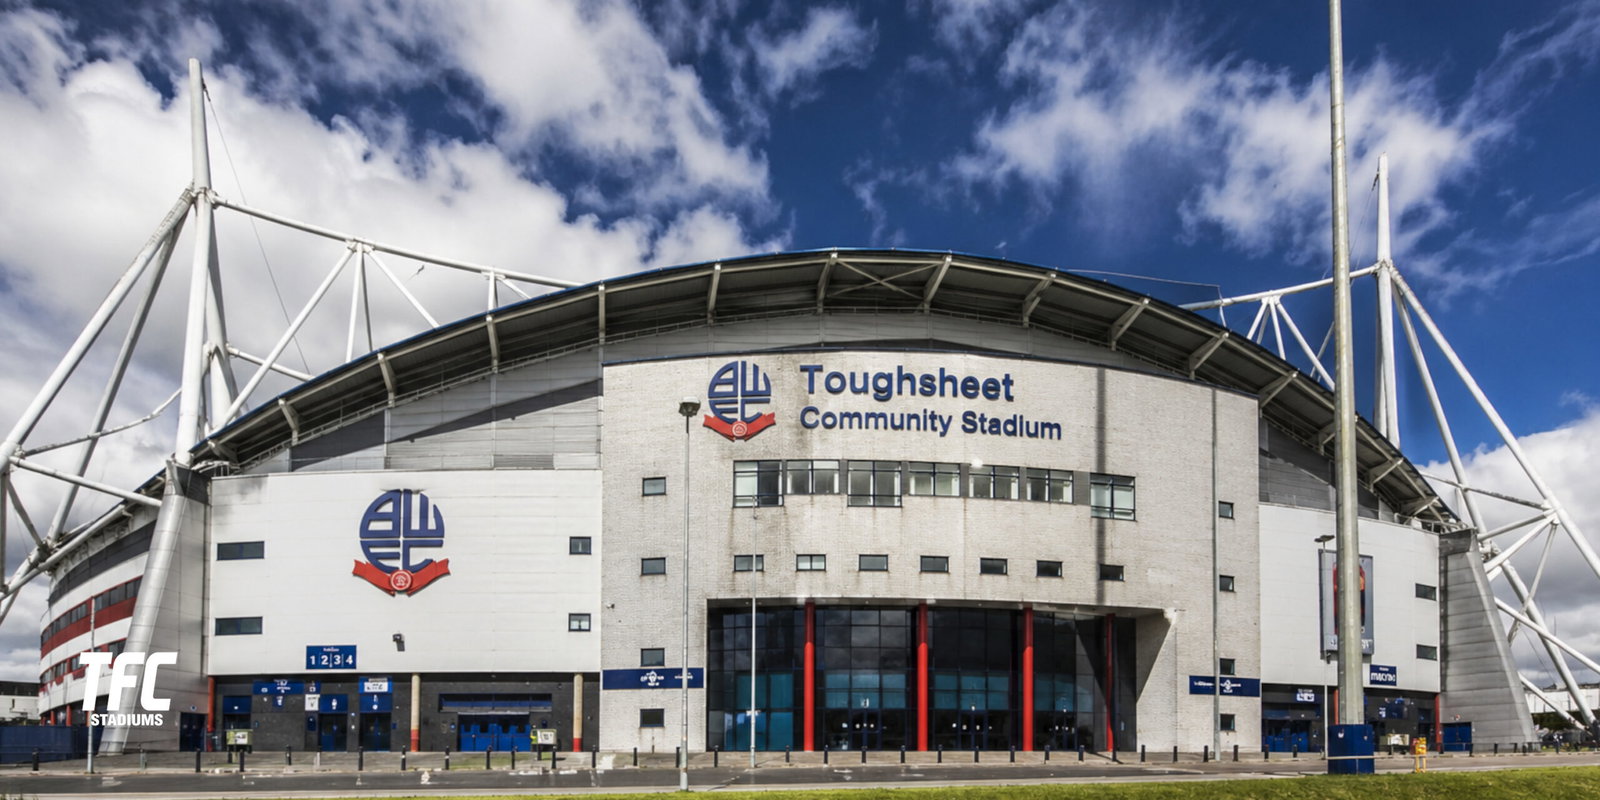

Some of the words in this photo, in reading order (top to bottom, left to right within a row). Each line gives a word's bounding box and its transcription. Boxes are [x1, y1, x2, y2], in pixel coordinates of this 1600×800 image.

[800, 364, 1014, 400] Toughsheet
[800, 406, 951, 436] Community
[962, 411, 1062, 439] Stadium
[310, 655, 316, 665] 1
[321, 655, 329, 665] 2
[333, 655, 341, 665] 3
[345, 655, 353, 665] 4
